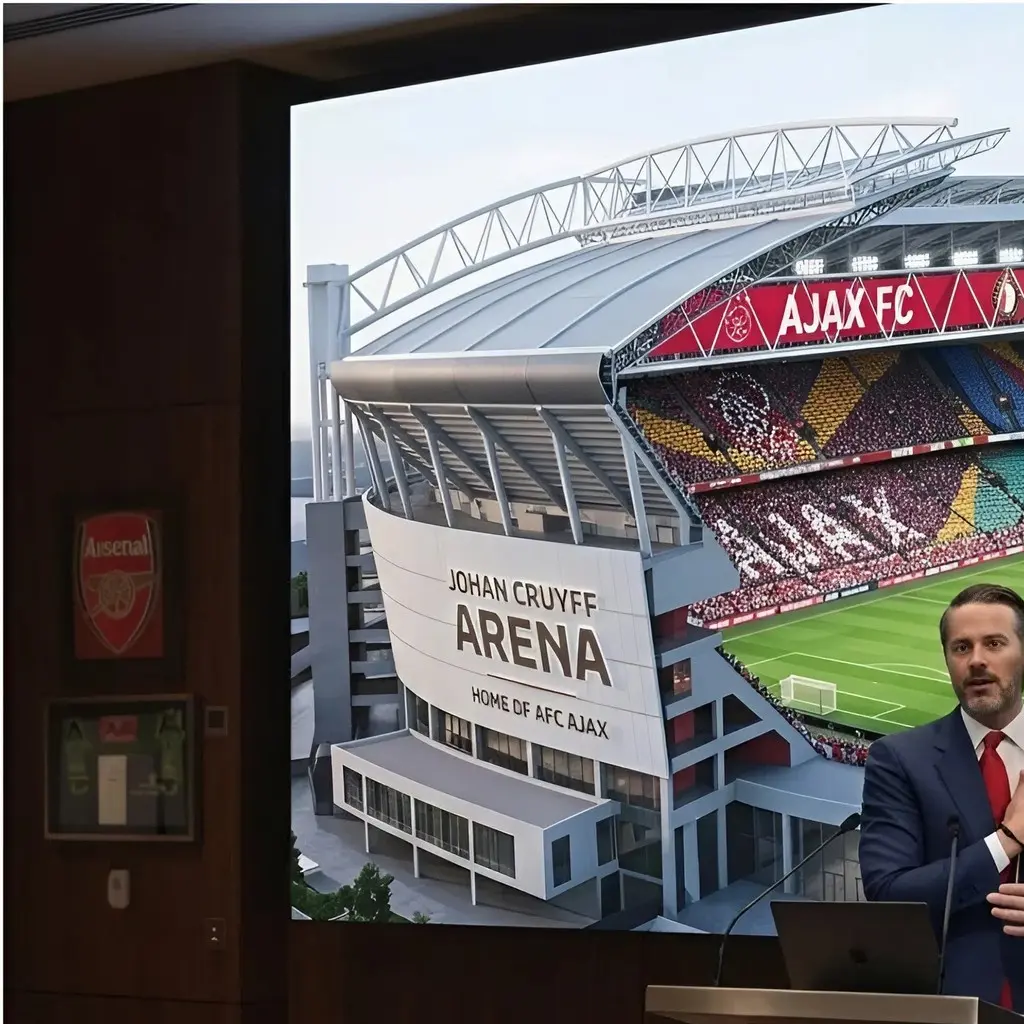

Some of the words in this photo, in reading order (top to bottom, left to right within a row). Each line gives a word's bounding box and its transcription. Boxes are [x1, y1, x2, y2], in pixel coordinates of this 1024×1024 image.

[778, 287, 866, 336] AJAX
[876, 284, 915, 326] FC
[84, 534, 149, 558] Arsenal
[449, 569, 509, 603] JOHAN
[512, 580, 597, 617] CRUYFF
[456, 604, 613, 688] ARENA
[471, 686, 510, 713] HOME
[513, 699, 531, 718] OF
[535, 704, 564, 729] AFC
[567, 713, 610, 740] AJAX
